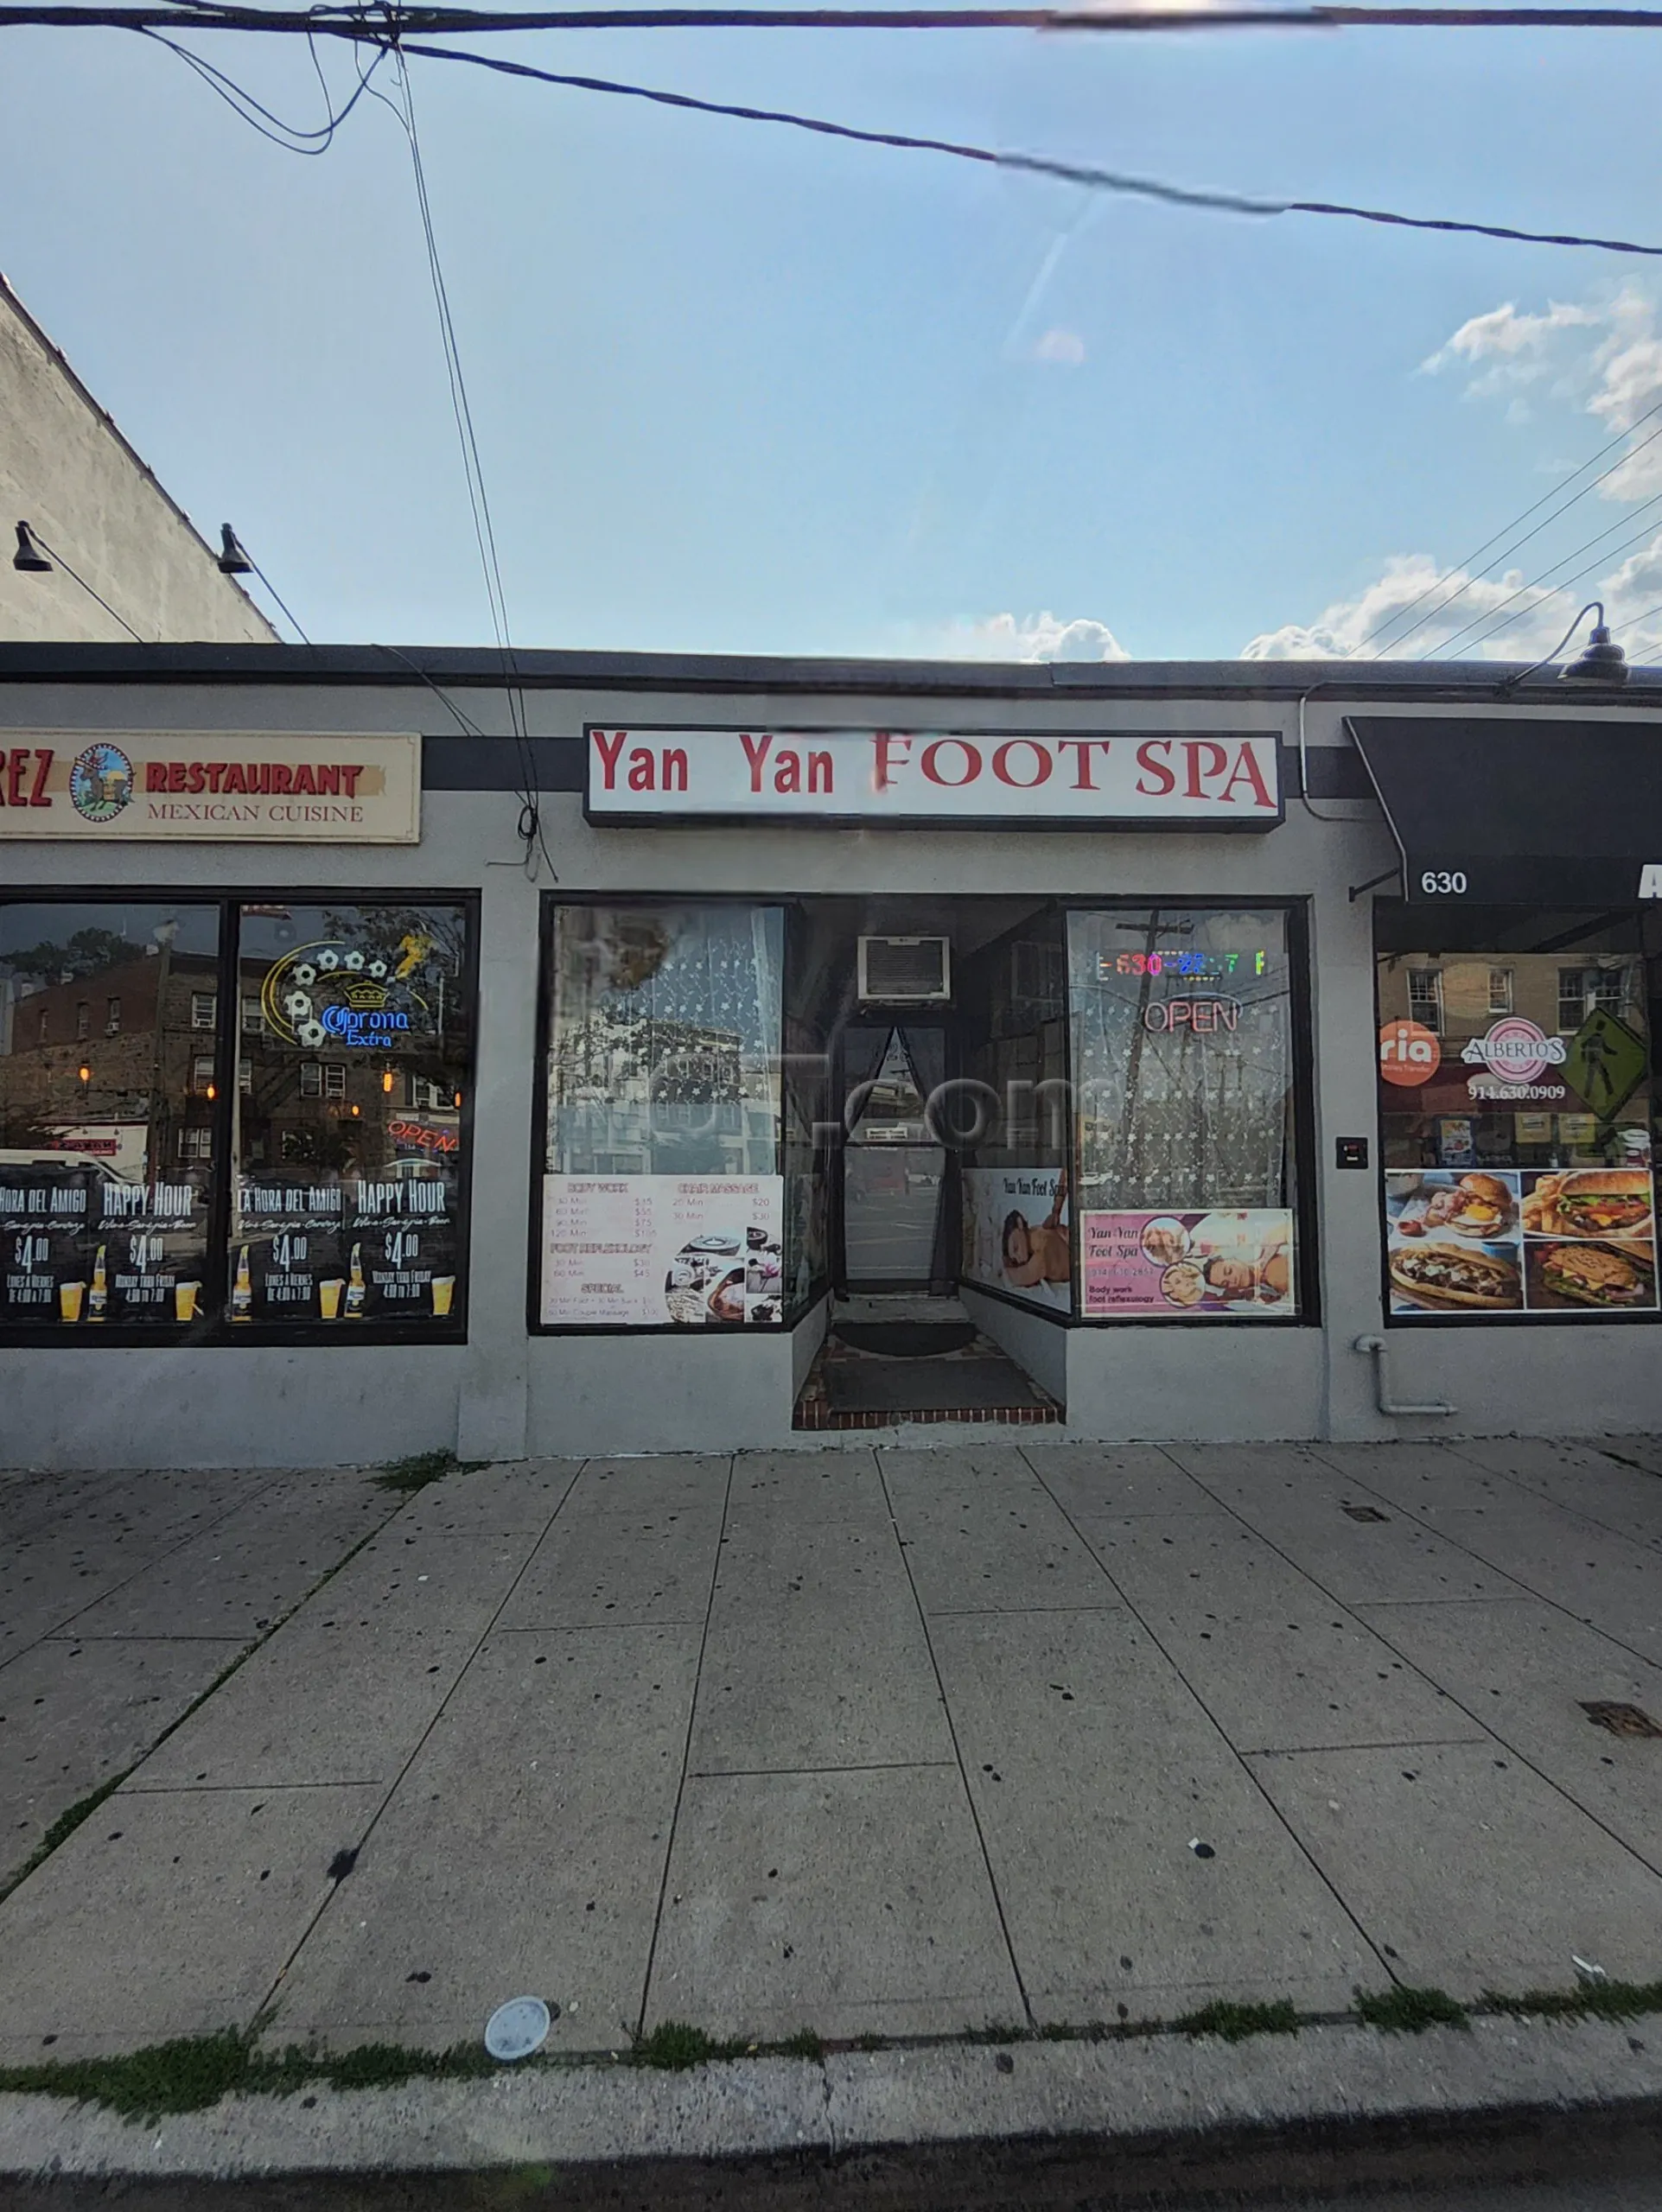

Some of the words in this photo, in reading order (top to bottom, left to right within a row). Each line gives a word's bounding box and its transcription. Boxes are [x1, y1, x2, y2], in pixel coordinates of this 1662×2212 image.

[146, 761, 365, 798] RESTAURANT
[592, 730, 689, 792] Yan
[739, 734, 834, 794] Yan
[868, 731, 1110, 792] FOOT
[1135, 740, 1278, 810] SPA
[147, 803, 259, 821] MEXICAN
[269, 804, 363, 823] CUISINE
[1422, 872, 1468, 893] 630
[322, 1005, 410, 1034] Corona
[1144, 1001, 1238, 1033] OPEN
[346, 1029, 392, 1046] Extra
[1380, 1028, 1431, 1063] ria
[1465, 1039, 1563, 1061] ALBERTO'S
[1468, 1084, 1565, 1100] 914.630.0909
[388, 1121, 457, 1153] OPEN
[103, 1182, 151, 1217] HAPPY
[154, 1182, 192, 1217] HOUR
[358, 1180, 404, 1214] HAPPY
[409, 1179, 446, 1213] HOUR
[1088, 1227, 1111, 1239] Yan
[1116, 1226, 1138, 1238] Yan
[15, 1235, 48, 1274] $4.00
[130, 1235, 162, 1274] $4.00
[272, 1234, 308, 1272] $4.00
[385, 1231, 418, 1269] $4.00
[1117, 1244, 1138, 1259] Spa
